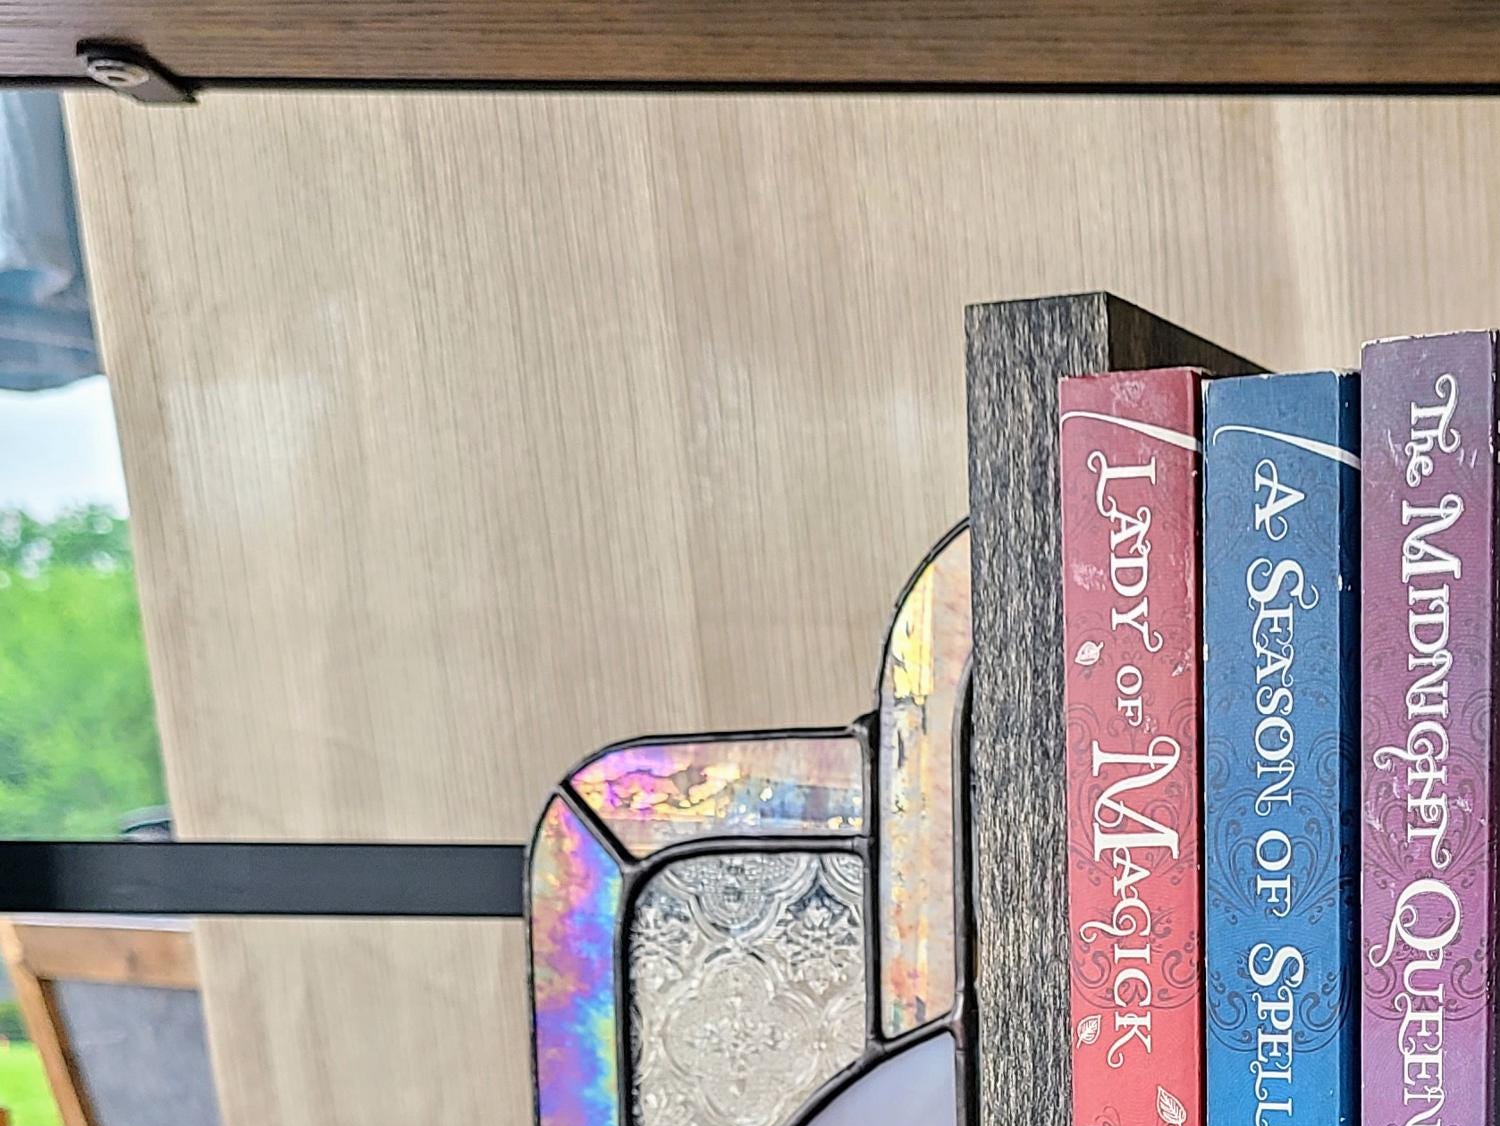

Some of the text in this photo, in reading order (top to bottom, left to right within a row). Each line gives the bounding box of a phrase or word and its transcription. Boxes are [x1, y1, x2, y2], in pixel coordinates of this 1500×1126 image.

[1087, 450, 1164, 654] LADY
[1253, 459, 1305, 541] A
[1246, 557, 1319, 818] SEASON
[1372, 492, 1466, 870] MIDNIGHT
[1079, 736, 1182, 1069] MAGICK
